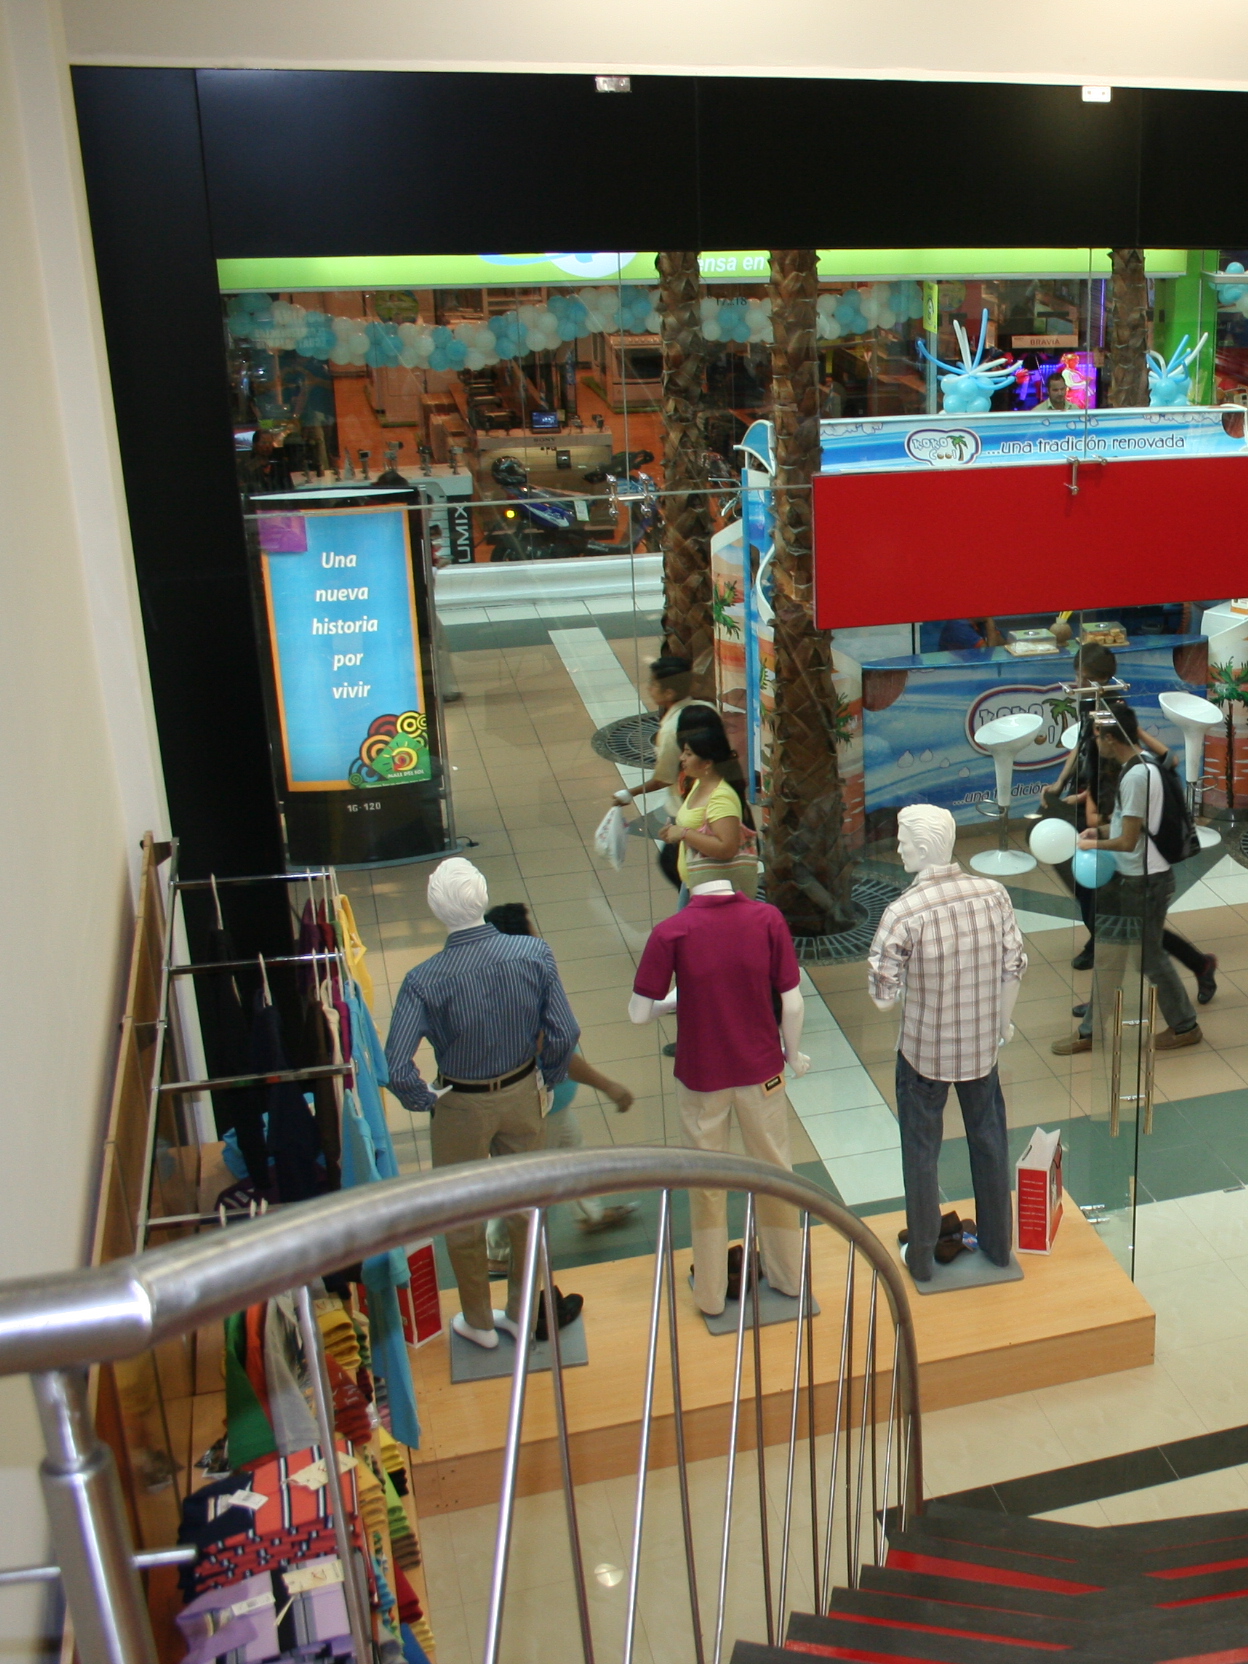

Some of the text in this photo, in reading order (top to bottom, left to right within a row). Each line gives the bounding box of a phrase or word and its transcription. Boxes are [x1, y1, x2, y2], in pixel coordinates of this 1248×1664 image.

[743, 256, 765, 271] en
[1037, 435, 1107, 453] tradición
[1112, 433, 1185, 450] renovada
[454, 502, 471, 563] UMIX
[321, 551, 357, 569] Una
[315, 586, 369, 602] nueva
[312, 615, 378, 635] historia
[333, 653, 364, 671] por
[332, 681, 371, 699] vivir
